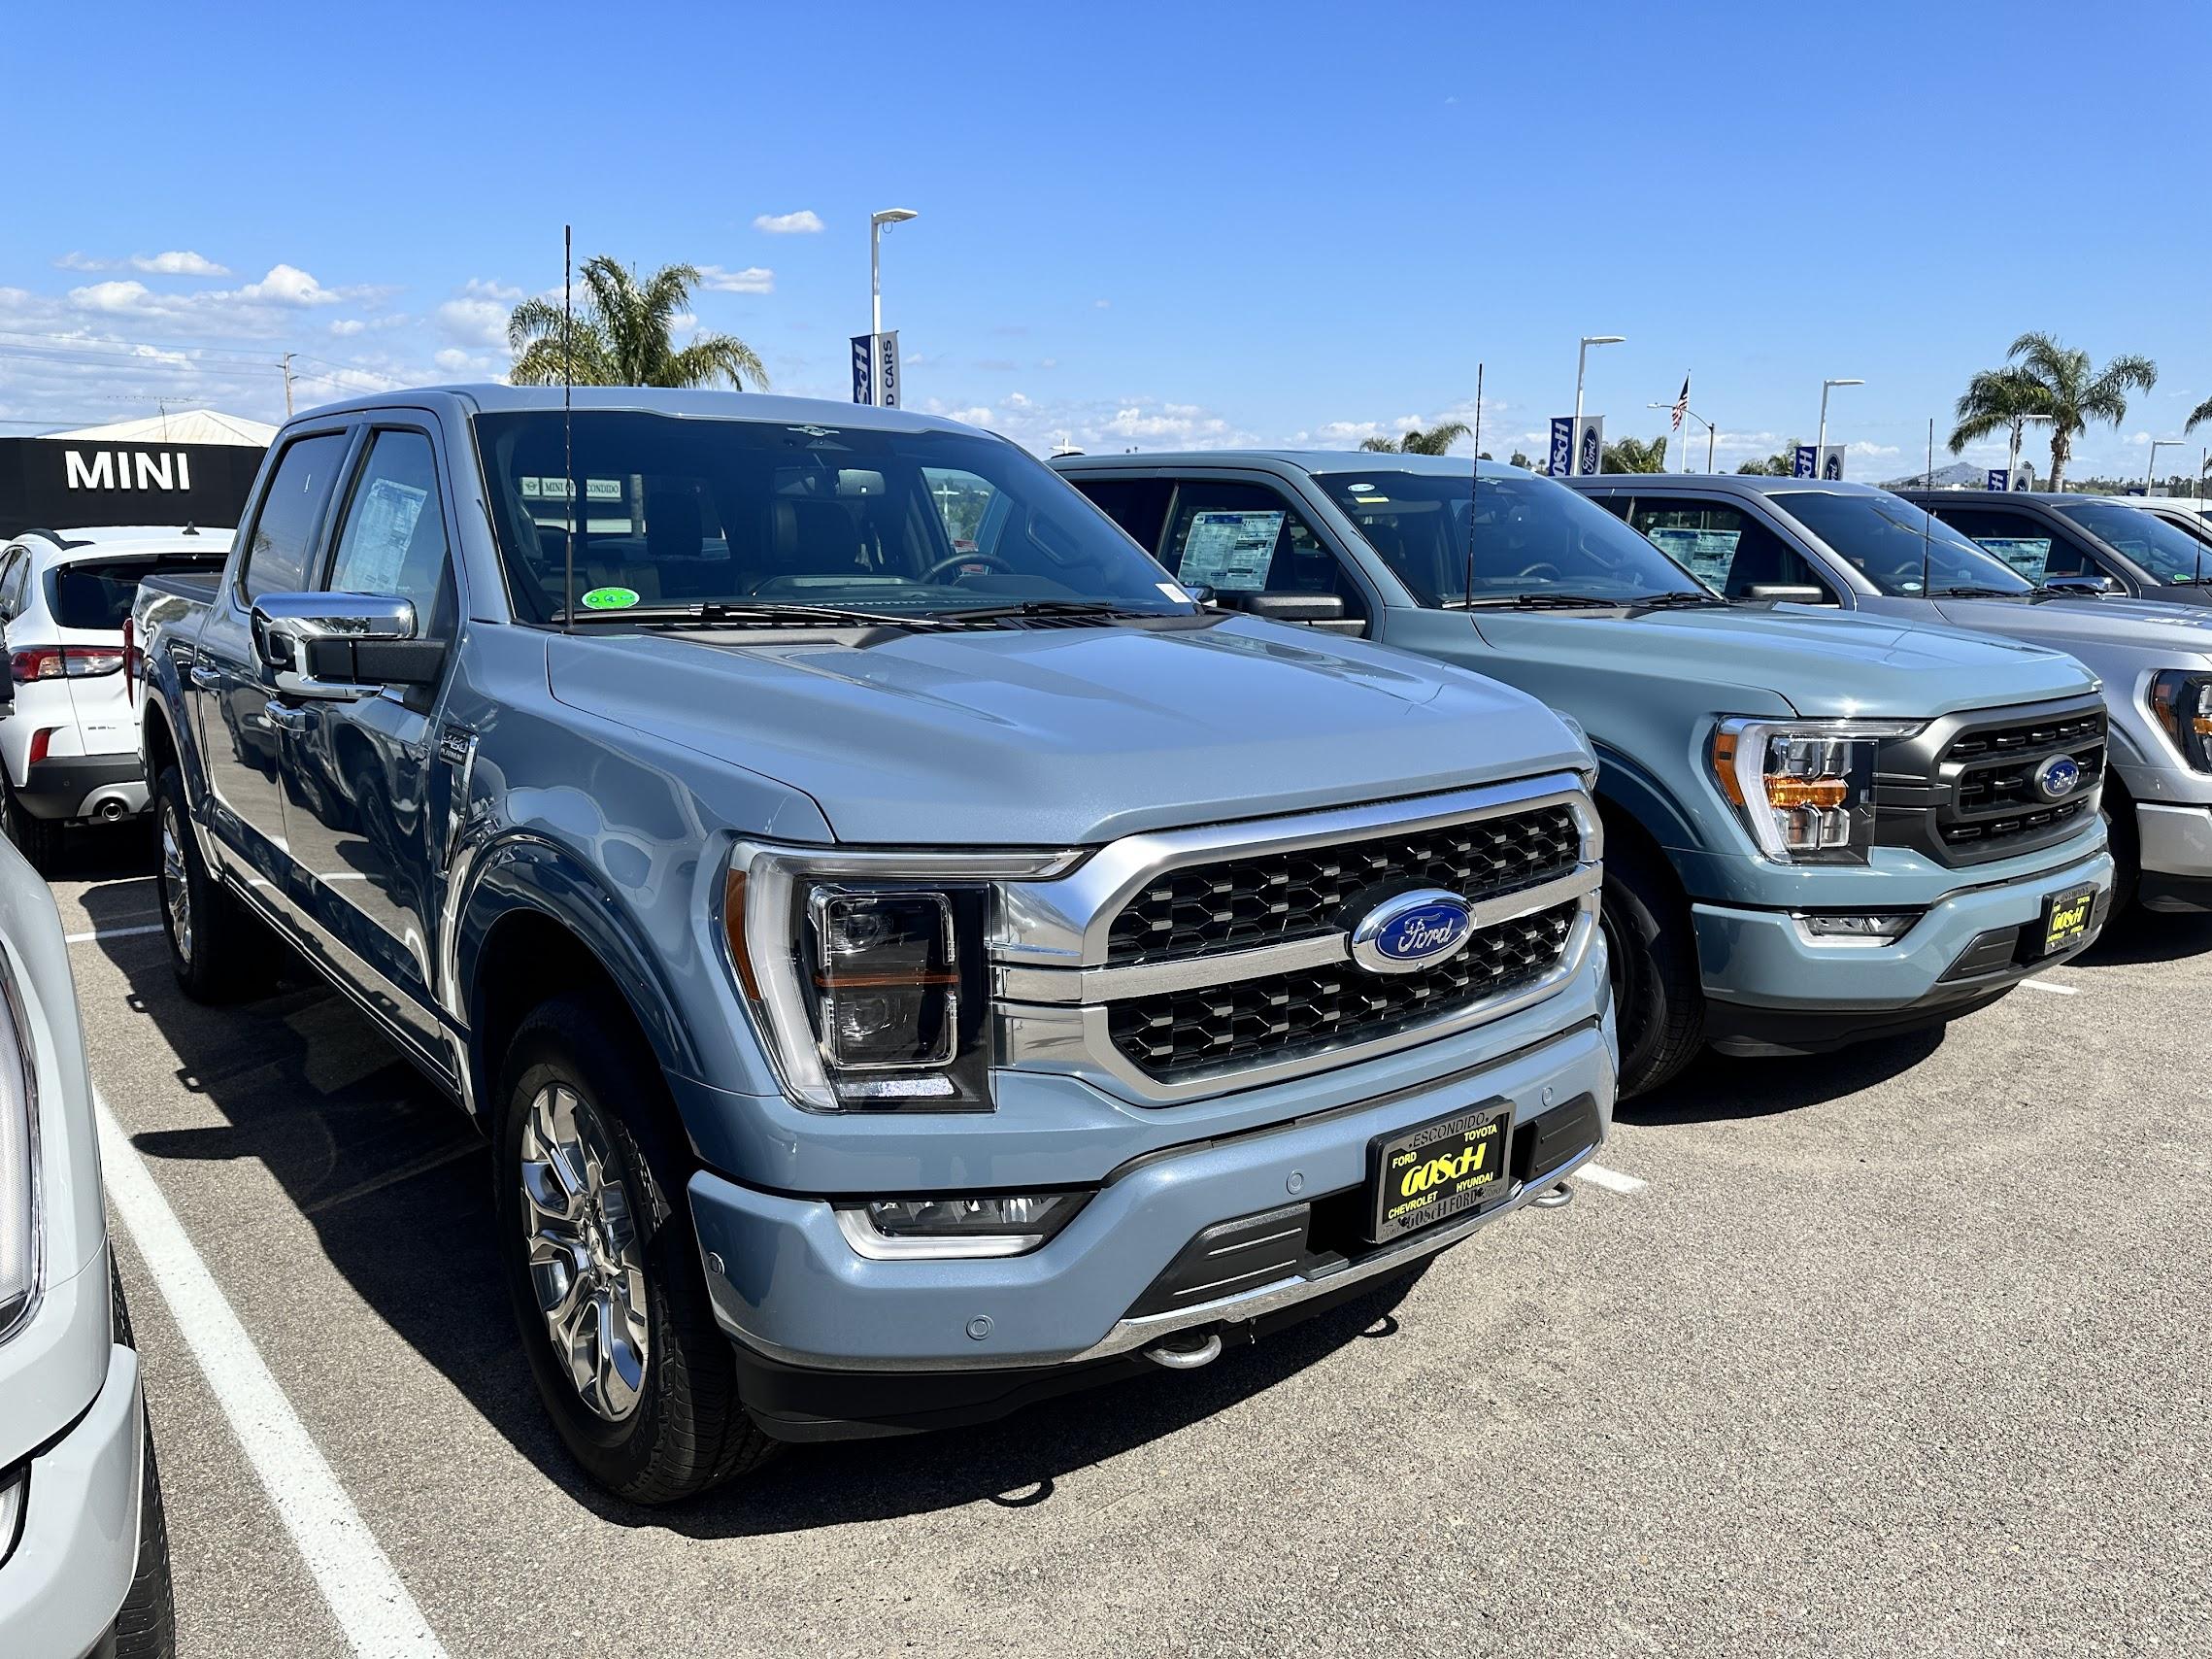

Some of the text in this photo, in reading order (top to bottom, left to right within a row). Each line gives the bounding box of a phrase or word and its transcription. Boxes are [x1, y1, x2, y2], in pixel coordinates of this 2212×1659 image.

[884, 340, 894, 389] CARS
[1582, 437, 1596, 473] Ford
[64, 450, 190, 491] MINI
[545, 482, 563, 492] MINI
[1398, 912, 1454, 953] Ford
[1413, 1112, 1486, 1148] ESCONDIDO
[1464, 1124, 1497, 1142] TOYOTA
[1392, 1151, 1417, 1168] FORD
[1457, 1171, 1493, 1193] HYUNDAI
[1388, 1191, 1438, 1219] CHEVROLET
[1450, 1190, 1477, 1212] FORD
